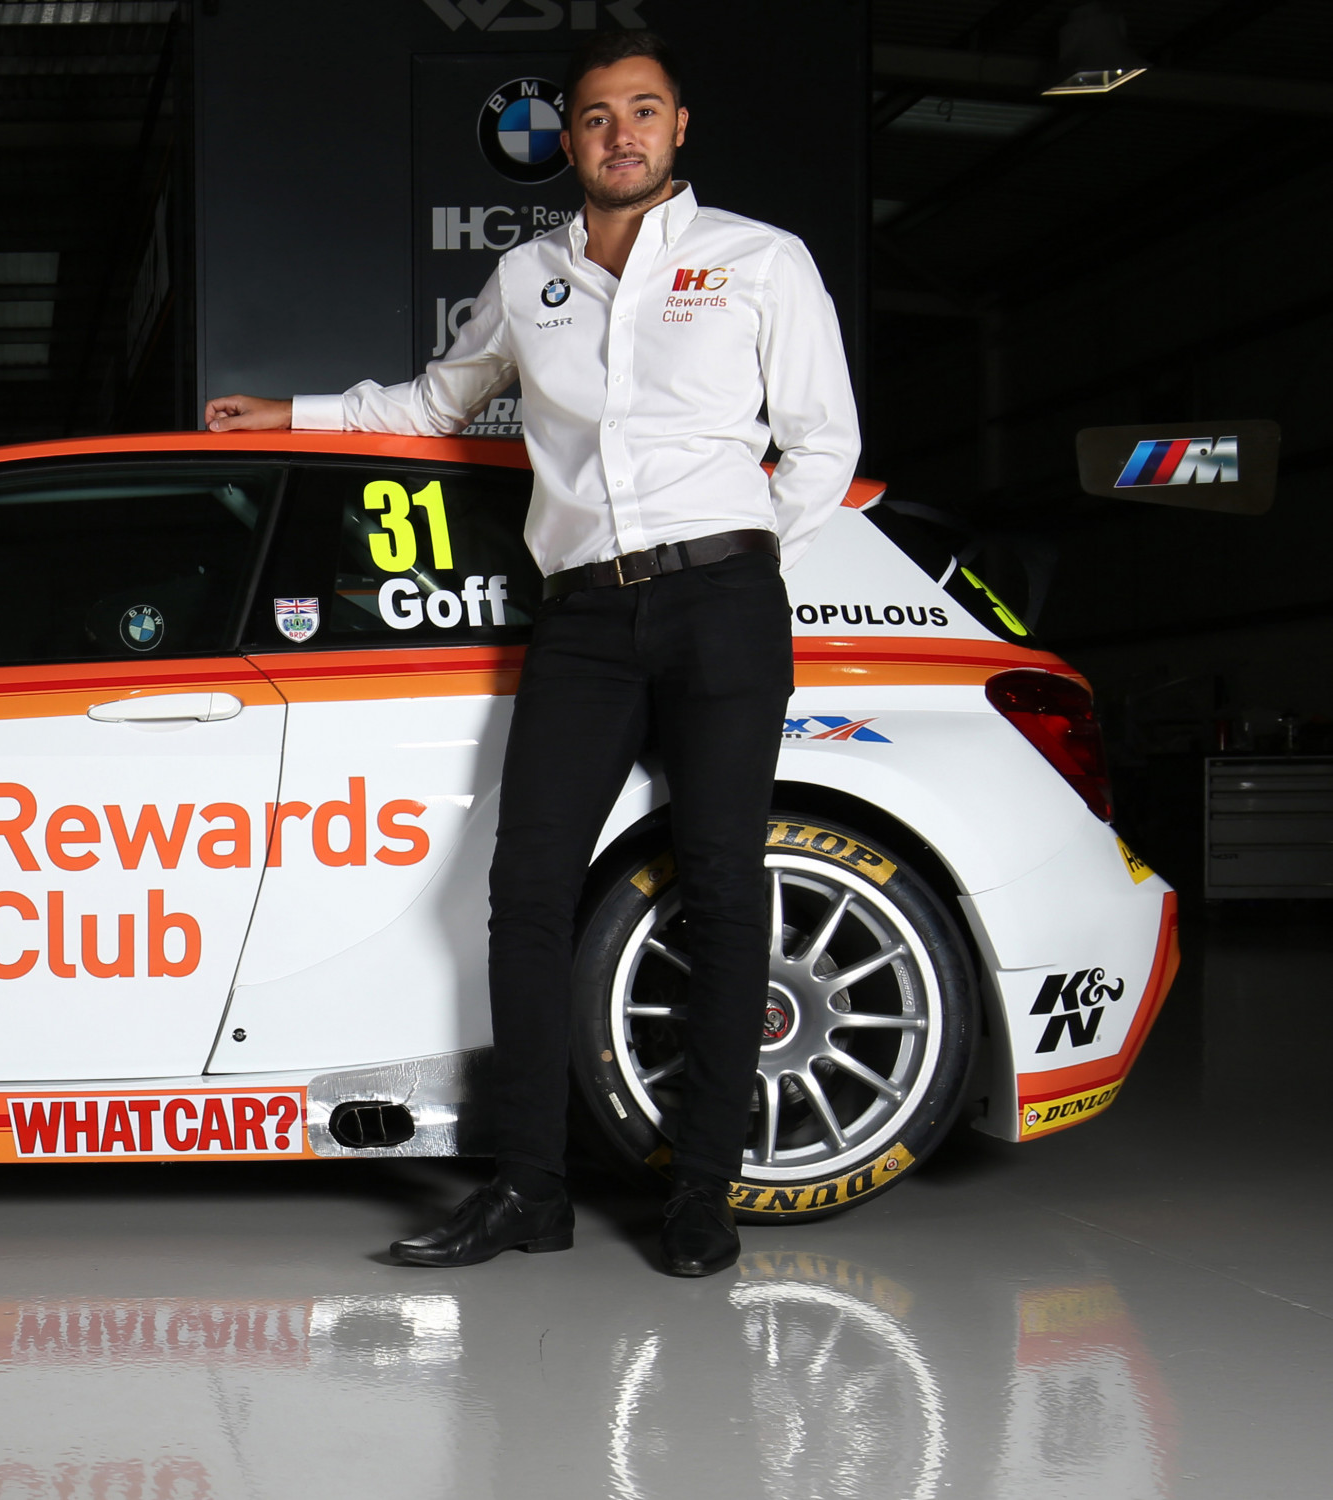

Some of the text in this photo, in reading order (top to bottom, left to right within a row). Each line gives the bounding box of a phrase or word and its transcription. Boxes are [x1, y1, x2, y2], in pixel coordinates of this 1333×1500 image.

[662, 310, 693, 323] Club
[665, 295, 727, 307] Rewards
[535, 316, 574, 330] WSR
[363, 480, 454, 573] 31
[378, 575, 508, 630] Goff
[789, 604, 948, 627] OPULOUS
[766, 822, 884, 868] LOP
[728, 1163, 876, 1212] DUNL
